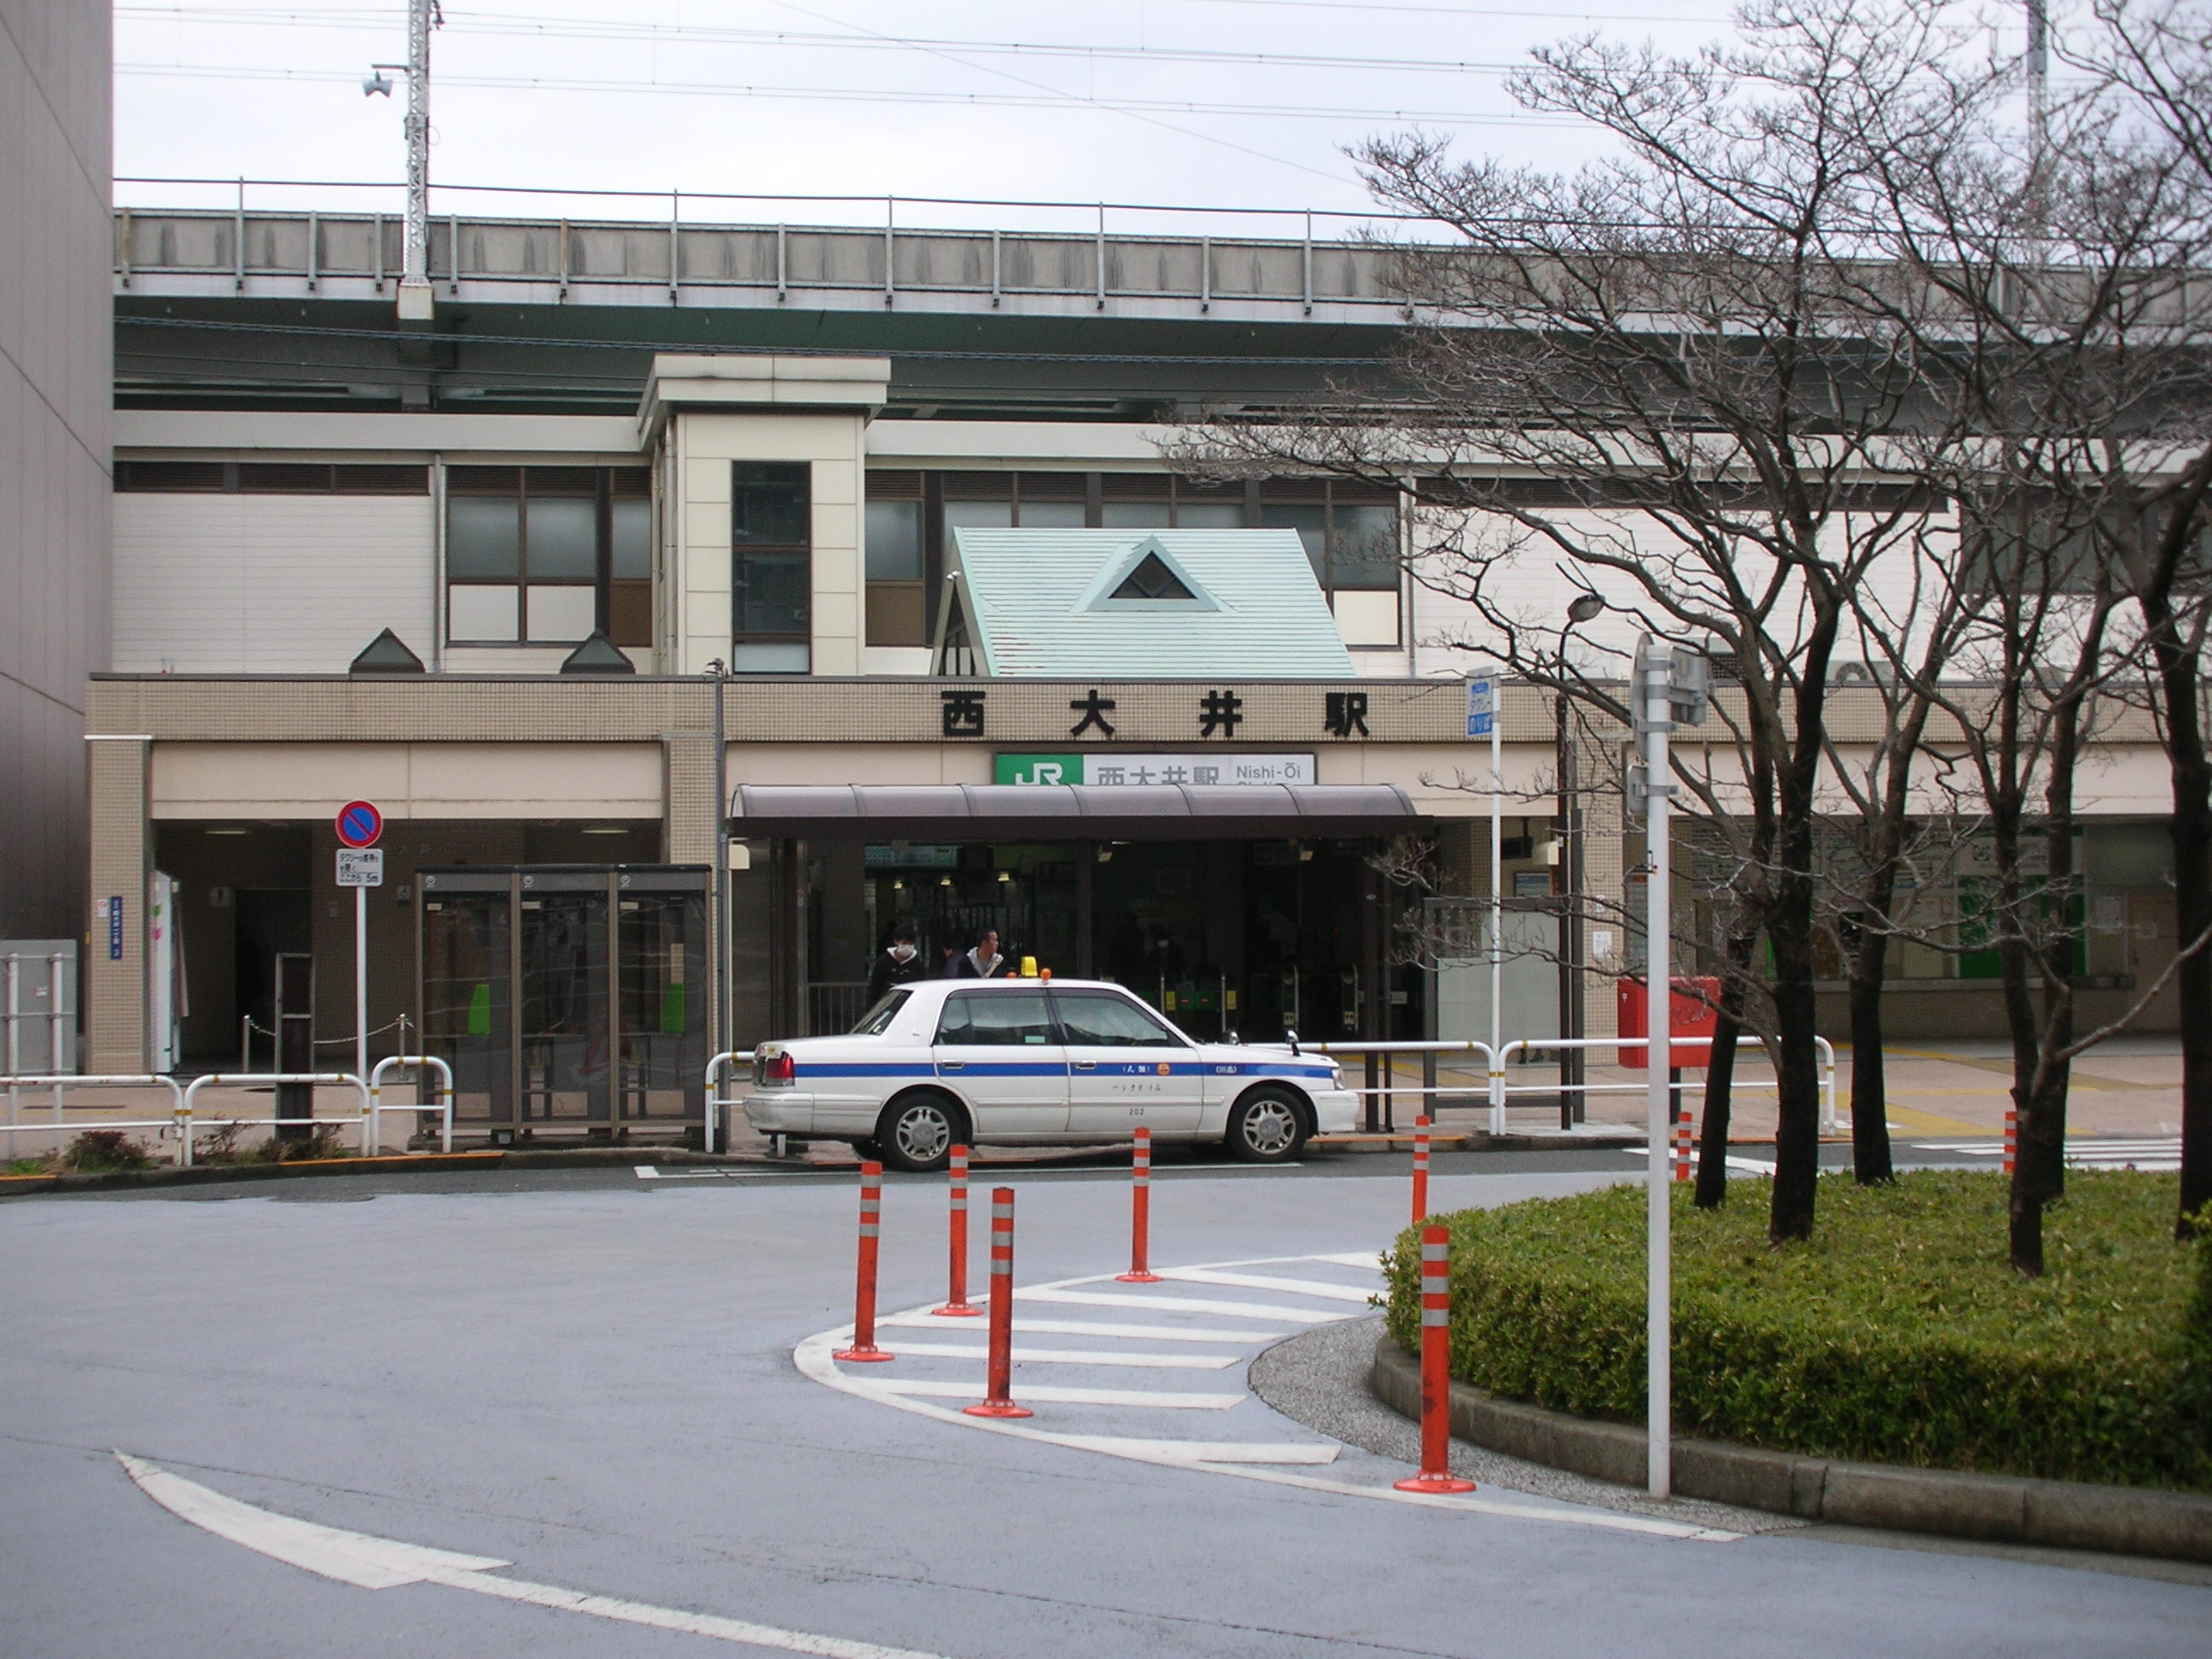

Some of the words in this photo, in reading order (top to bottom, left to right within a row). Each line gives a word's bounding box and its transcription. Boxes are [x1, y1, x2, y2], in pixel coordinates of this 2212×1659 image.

[941, 690, 1369, 736] 西大井駅
[1016, 763, 1063, 785] JR
